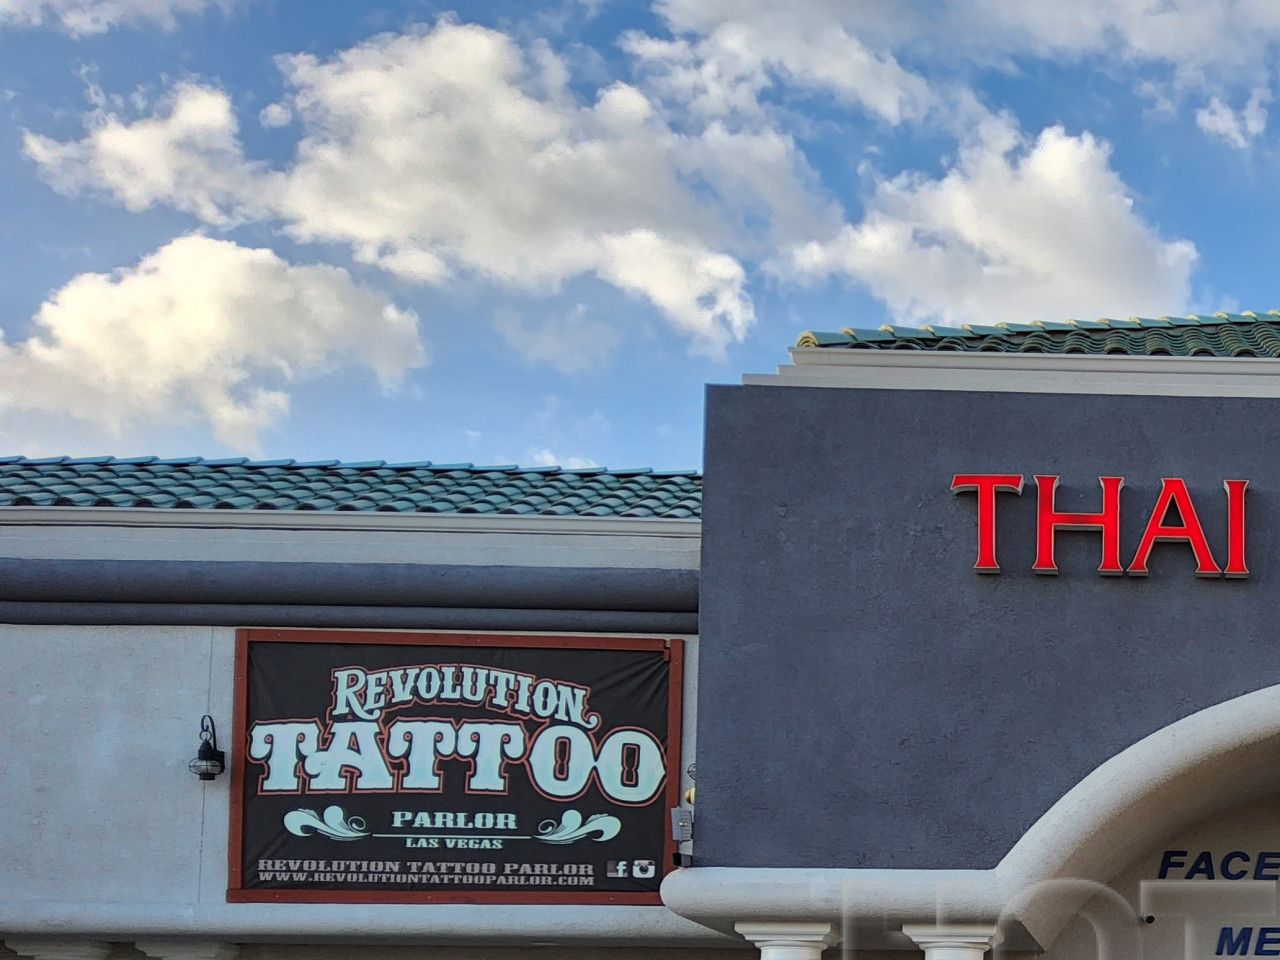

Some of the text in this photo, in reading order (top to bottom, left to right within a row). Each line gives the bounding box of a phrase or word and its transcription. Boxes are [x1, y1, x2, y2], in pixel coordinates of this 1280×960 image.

[950, 473, 1250, 578] THAI
[332, 665, 599, 729] REVOLUTION
[250, 720, 667, 803] TATTOO
[391, 811, 517, 830] PARLOR
[405, 838, 504, 850] LAS VEGAS
[257, 859, 594, 876] REVOLUTION TATTOO PARLOR
